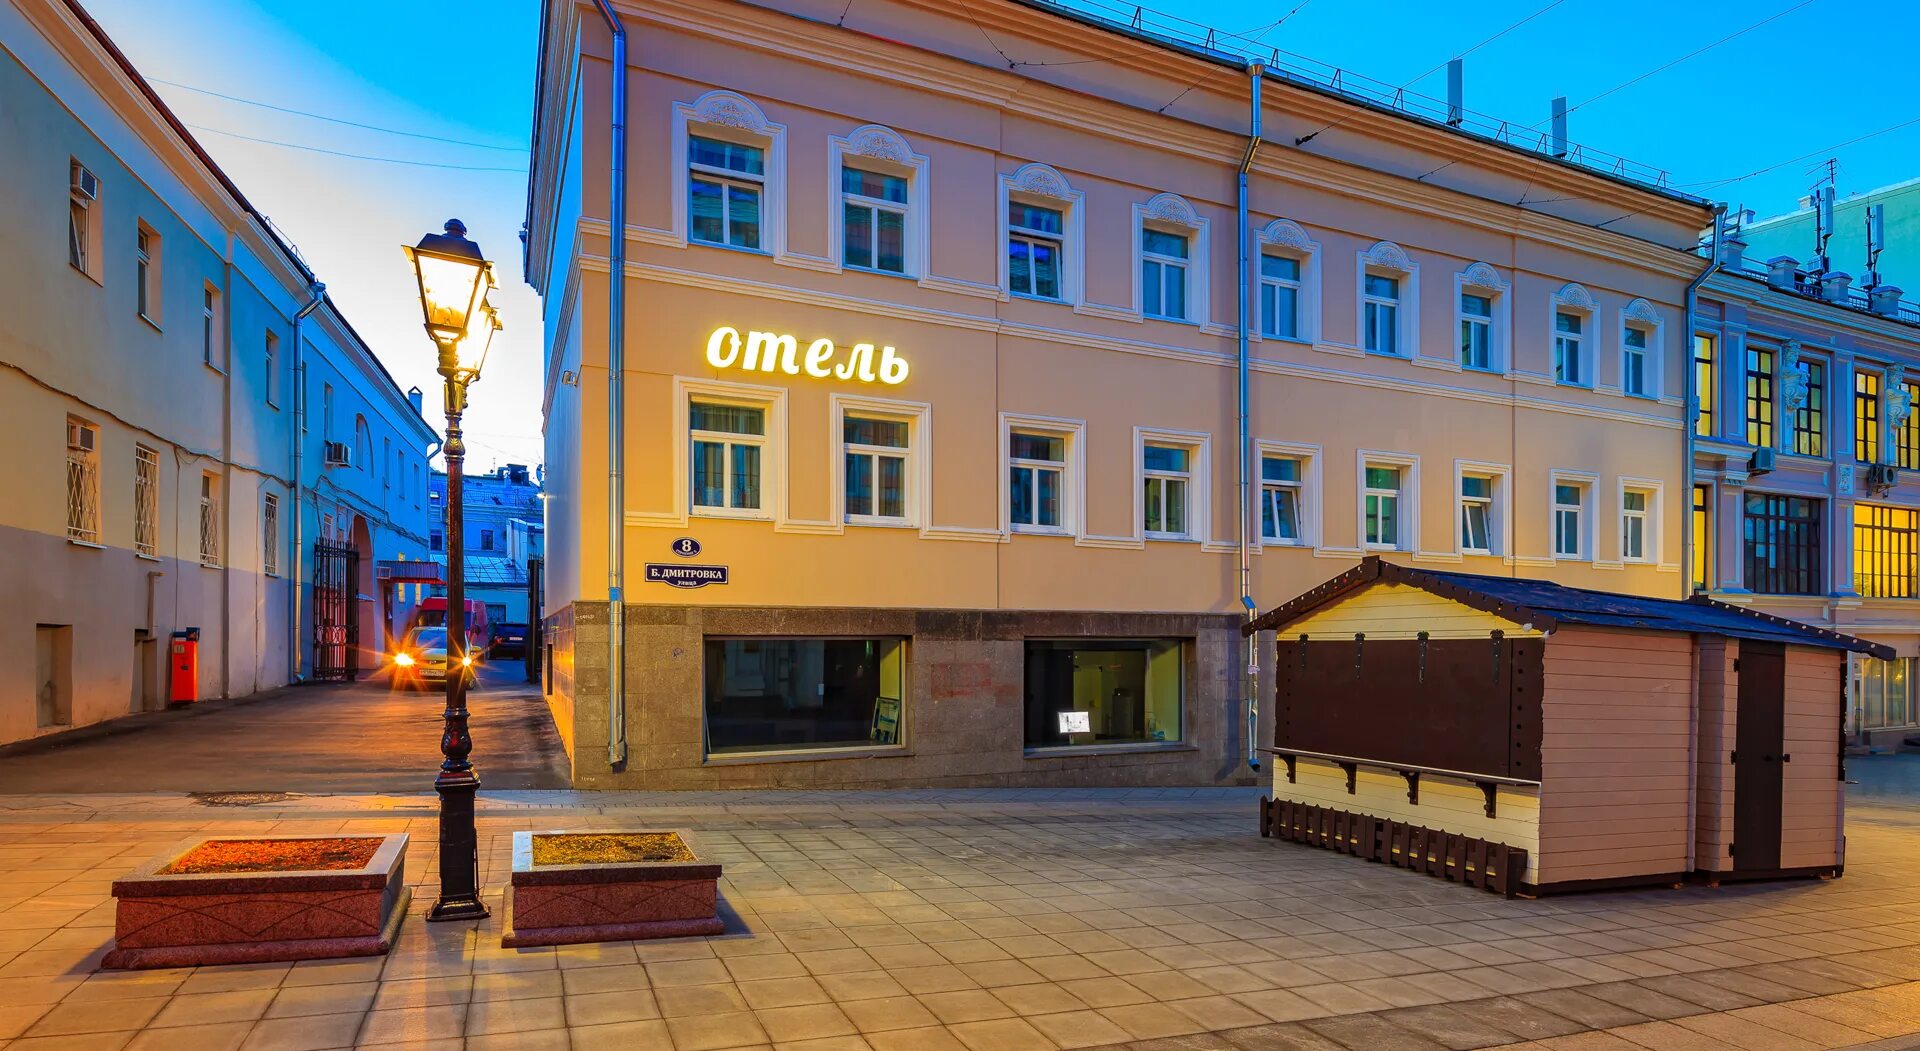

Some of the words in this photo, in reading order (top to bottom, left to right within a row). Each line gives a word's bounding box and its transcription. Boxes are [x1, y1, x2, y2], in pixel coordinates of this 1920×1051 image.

[706, 326, 909, 384] отель
[682, 540, 691, 552] 8
[651, 569, 660, 577] Б.
[662, 569, 722, 578] ДМИТРОВКА
